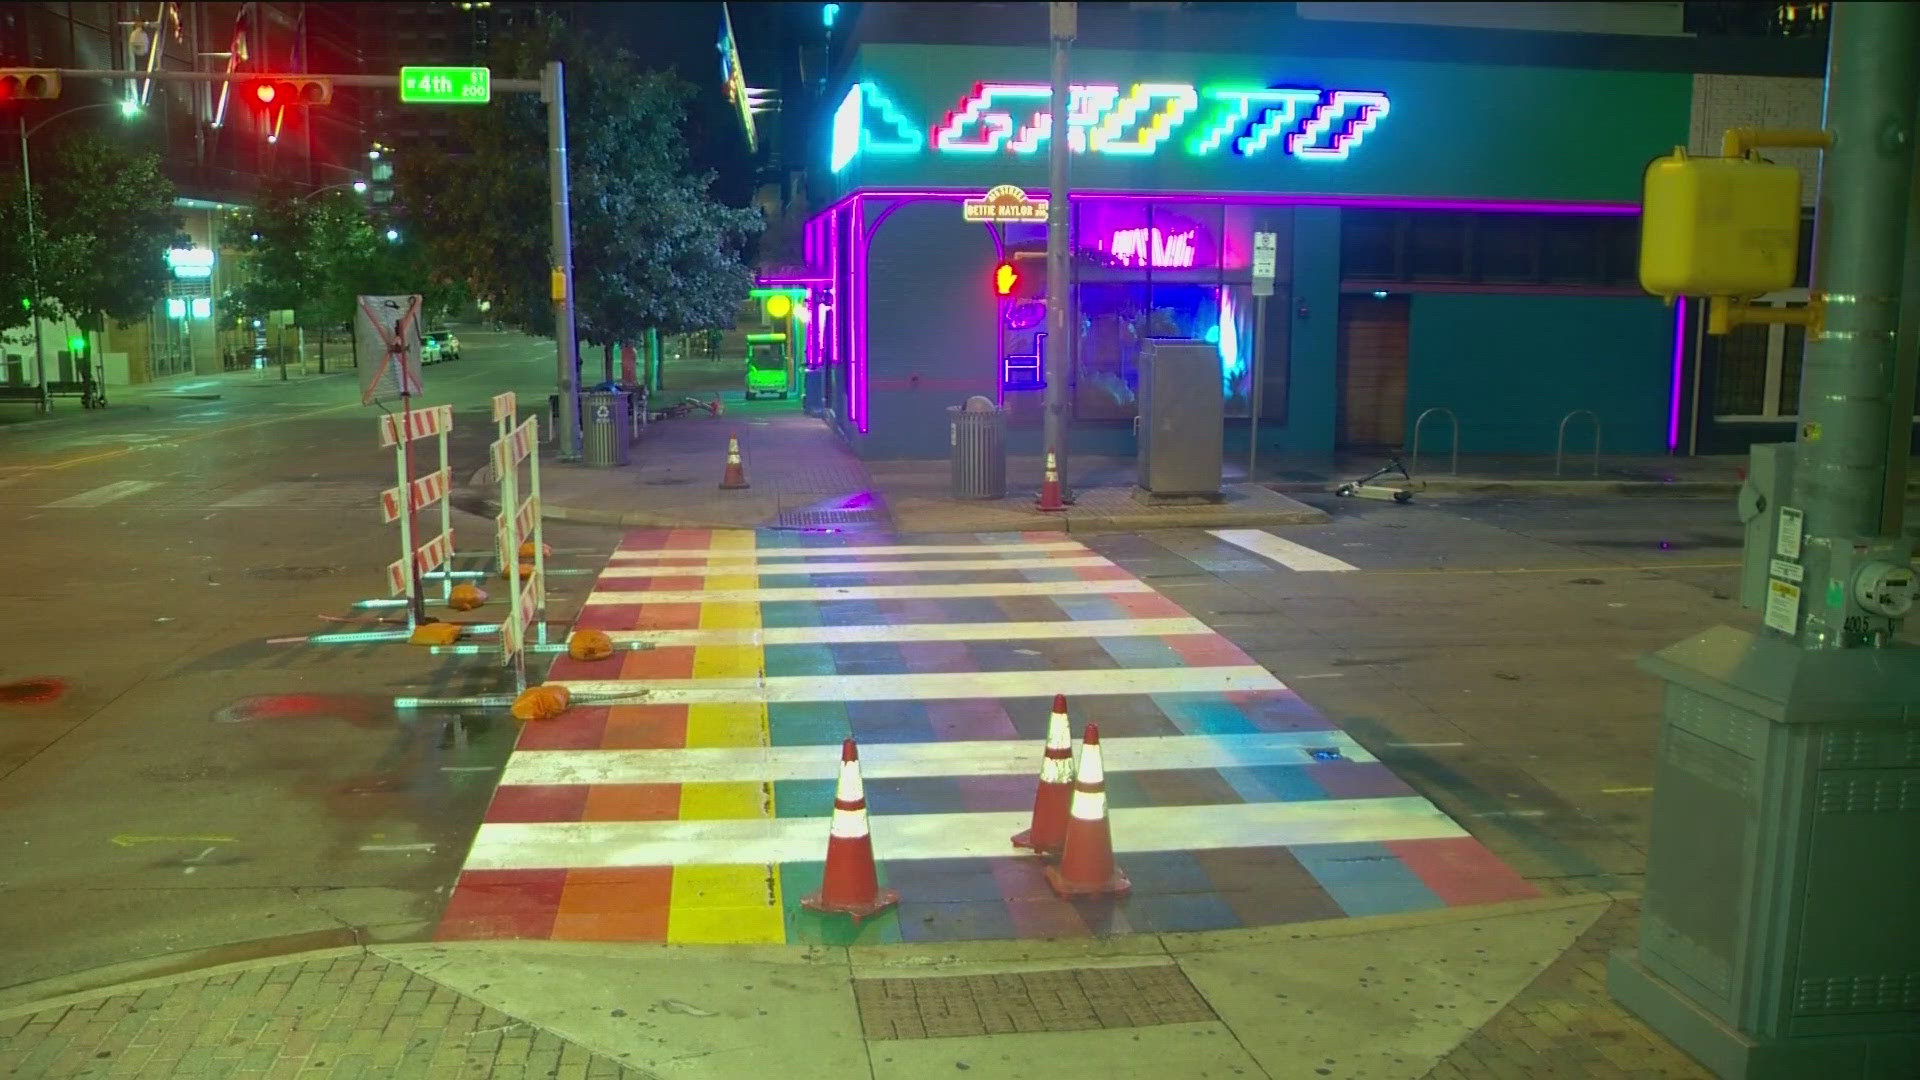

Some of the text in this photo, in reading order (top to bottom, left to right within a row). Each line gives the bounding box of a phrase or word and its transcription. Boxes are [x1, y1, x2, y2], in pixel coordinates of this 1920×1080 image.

[470, 71, 484, 83] ST
[418, 75, 453, 93] 4th
[462, 85, 486, 97] 200
[998, 205, 1033, 216] NAYLOR
